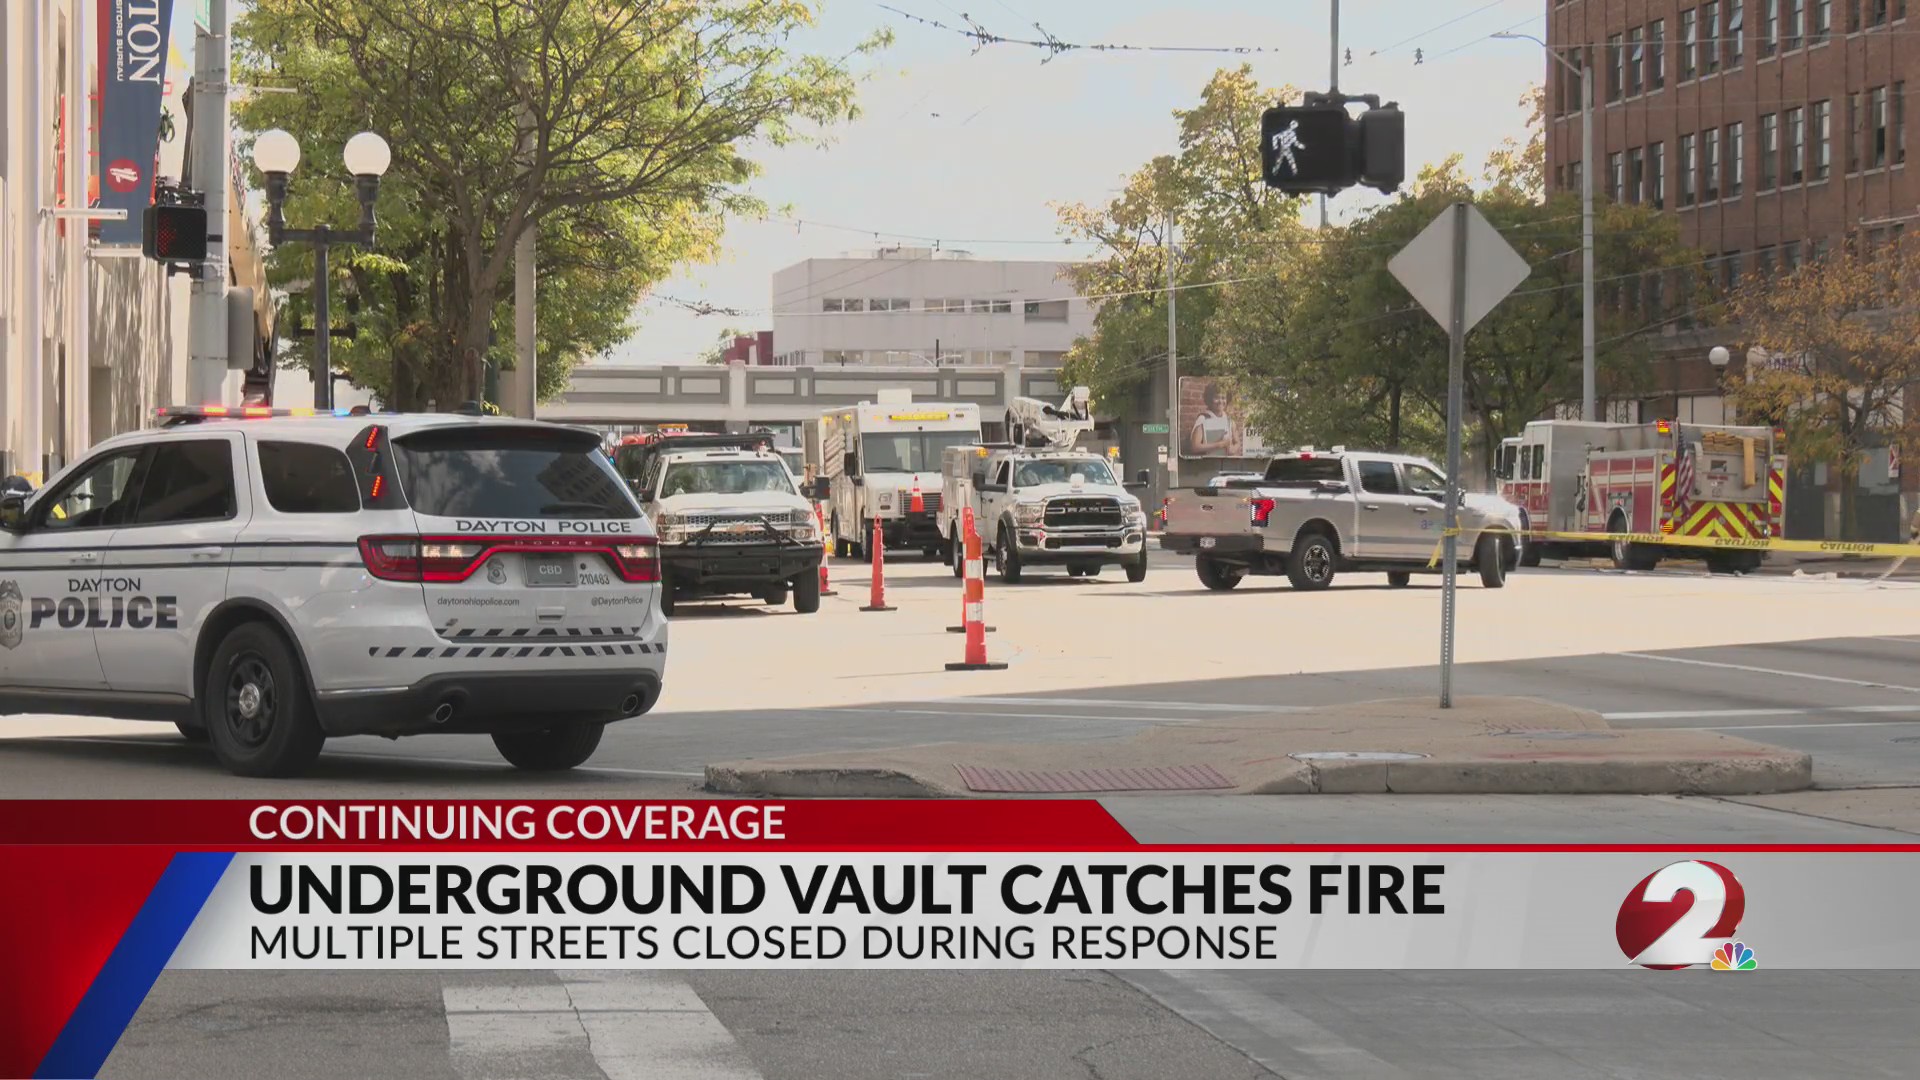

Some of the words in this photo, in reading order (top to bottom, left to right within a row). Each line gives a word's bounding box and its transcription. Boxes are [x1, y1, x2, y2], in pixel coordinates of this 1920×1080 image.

[116, 39, 124, 81] BUREAU
[456, 520, 546, 533] DAYTON
[559, 521, 632, 534] POLICE
[539, 565, 563, 576] CBD
[68, 577, 141, 592] DAYTON
[579, 573, 610, 586] 210483
[437, 597, 520, 608] daytonohiopolice.com
[591, 597, 644, 607] @DaytonPolice
[30, 595, 178, 629] POLICE
